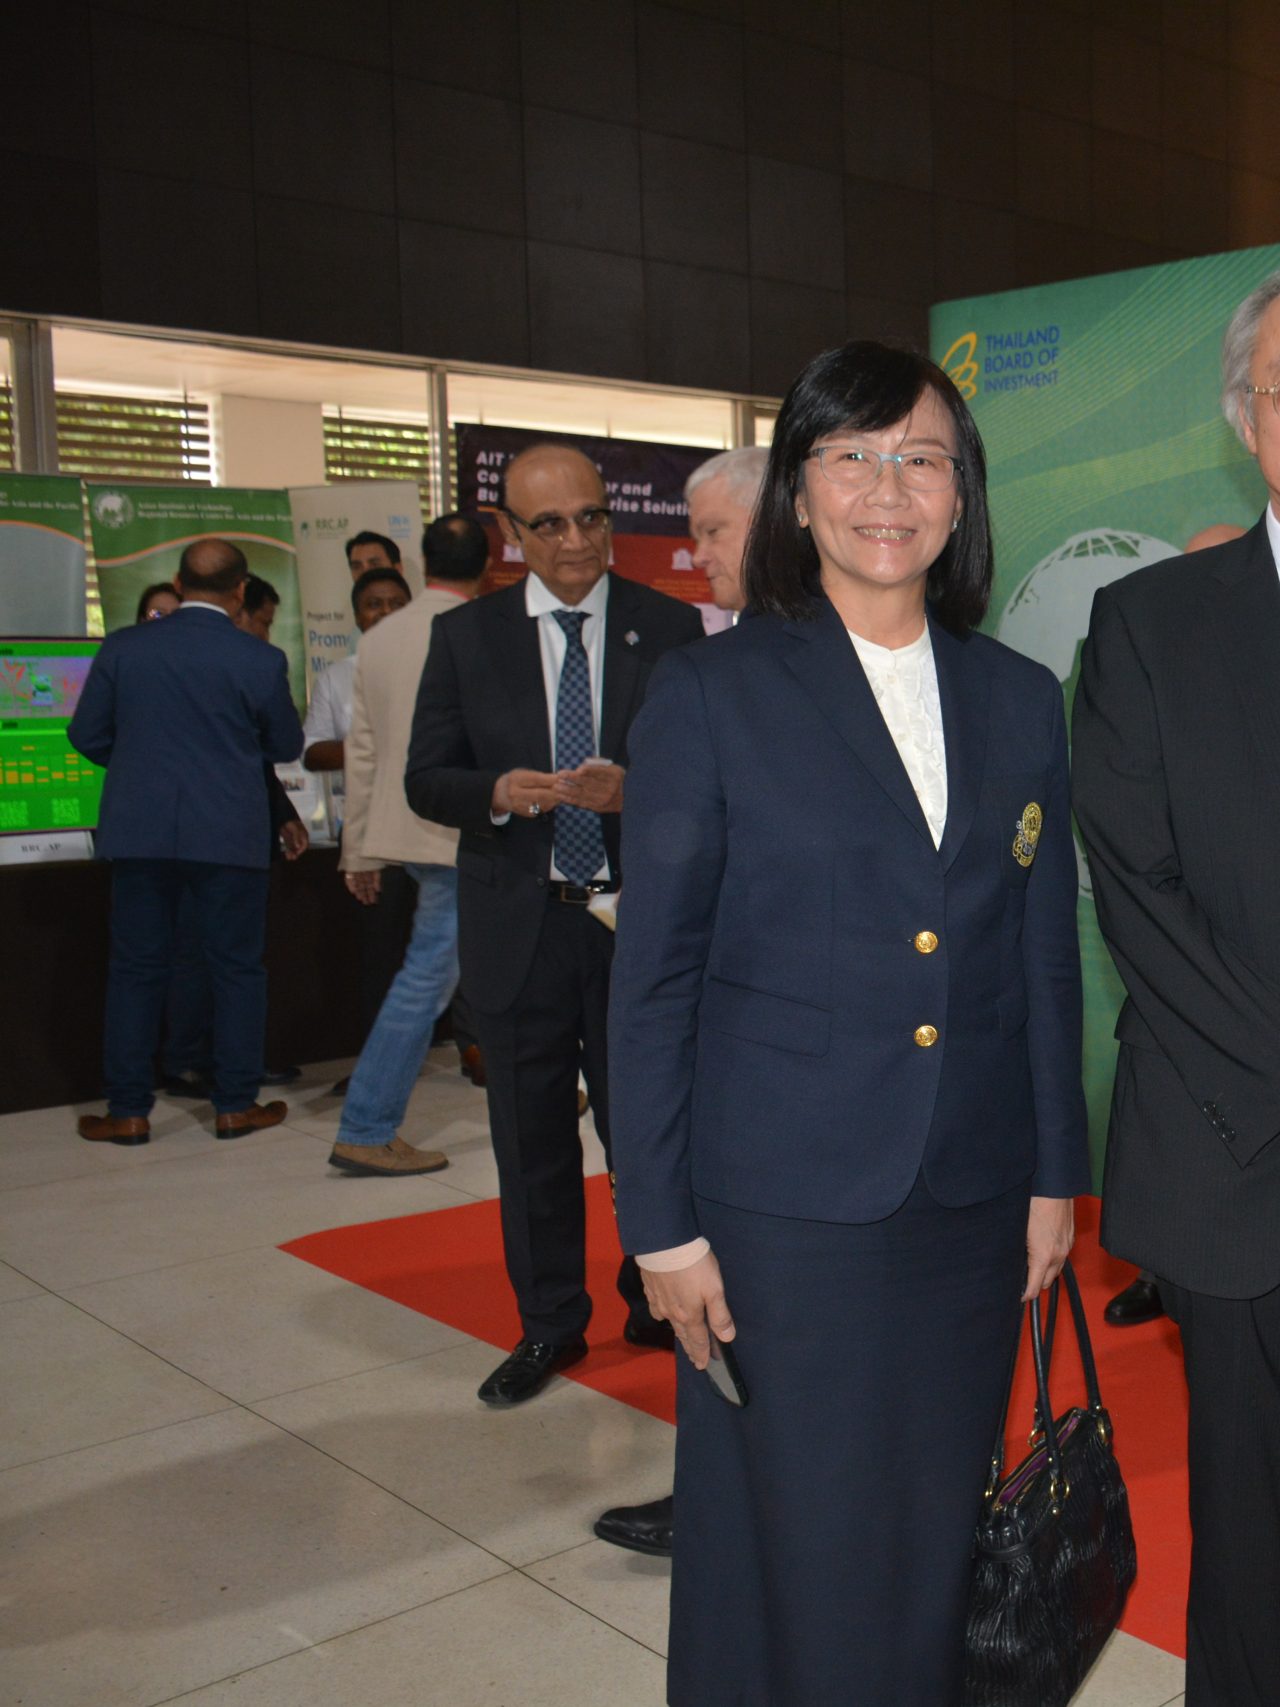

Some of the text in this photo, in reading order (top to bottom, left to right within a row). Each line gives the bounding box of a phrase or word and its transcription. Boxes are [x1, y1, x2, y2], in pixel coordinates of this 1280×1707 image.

[985, 325, 1060, 352] THAILAND
[984, 347, 1059, 374] BOARD OF
[984, 369, 1059, 393] INVESTMENT
[475, 451, 505, 466] AIT
[621, 484, 652, 497] and
[609, 498, 640, 513] rise
